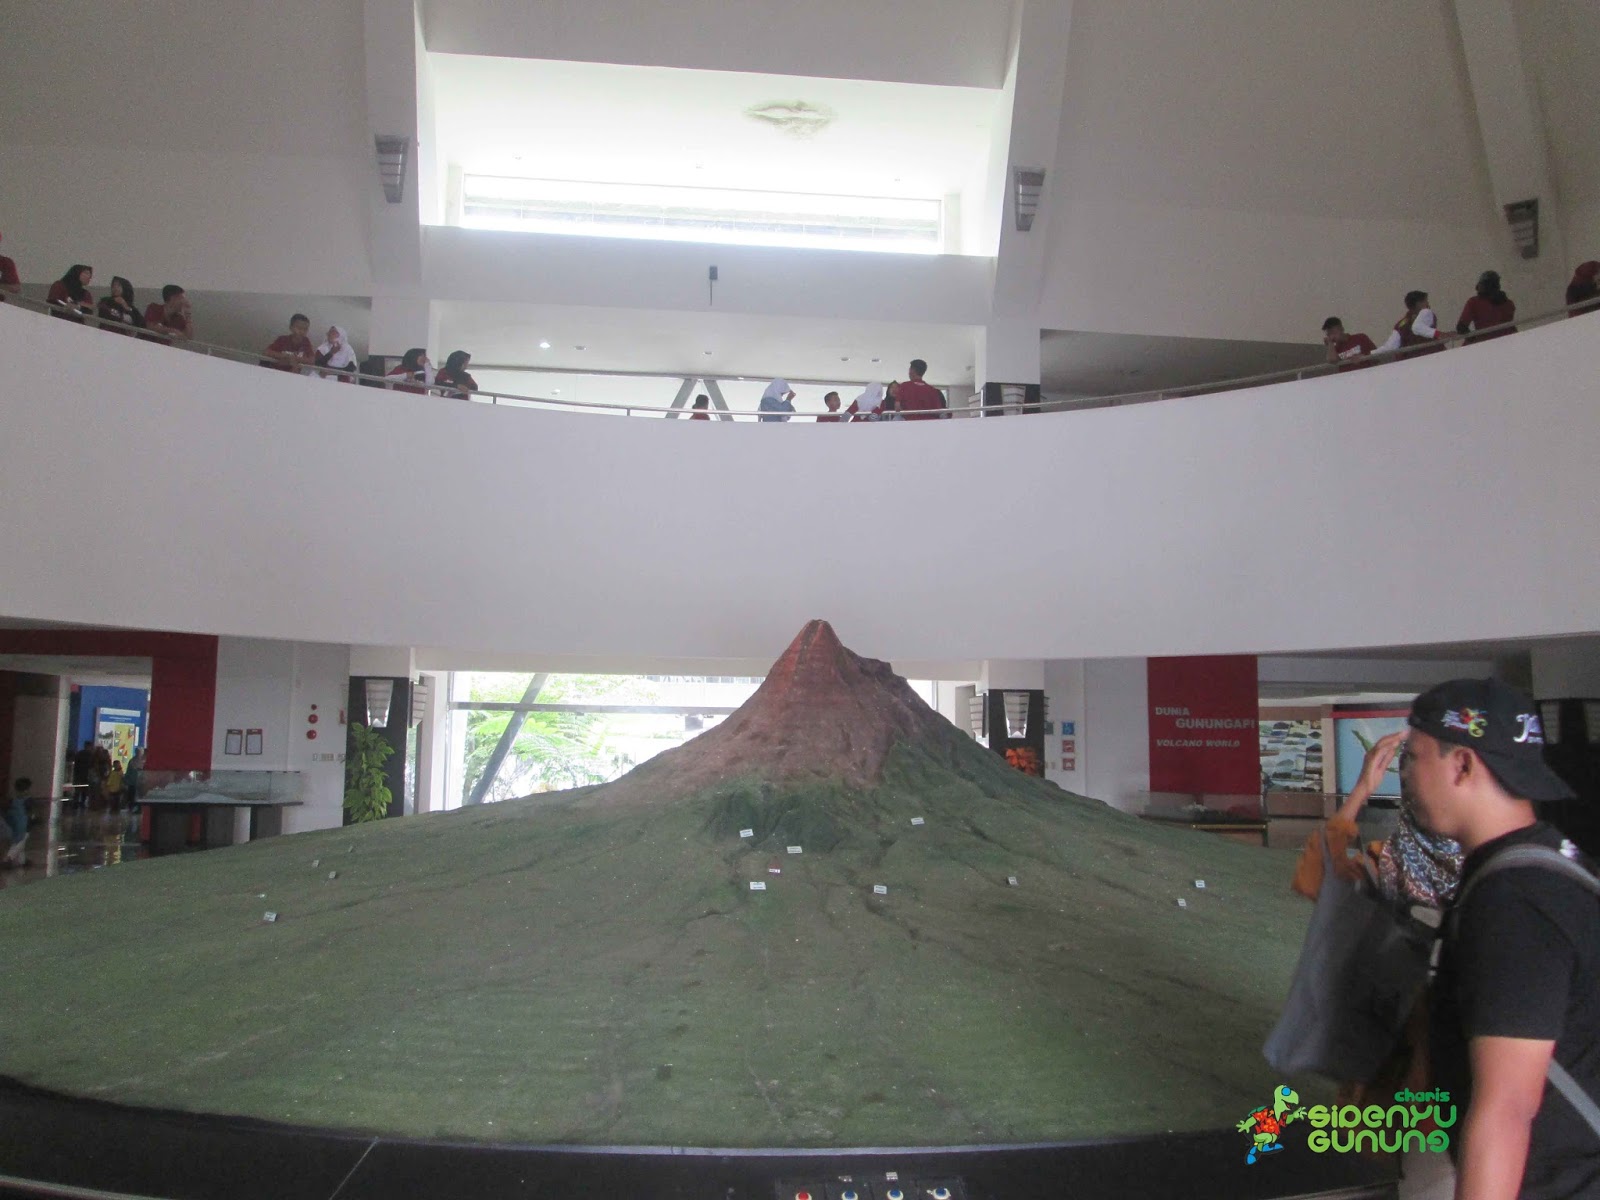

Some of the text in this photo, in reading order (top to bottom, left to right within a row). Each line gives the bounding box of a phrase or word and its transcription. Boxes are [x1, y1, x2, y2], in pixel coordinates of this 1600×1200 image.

[1155, 707, 1190, 716] DUNIA
[1175, 718, 1255, 729] GUNUNGAPI
[1156, 739, 1241, 748] VOLCANO WORLD
